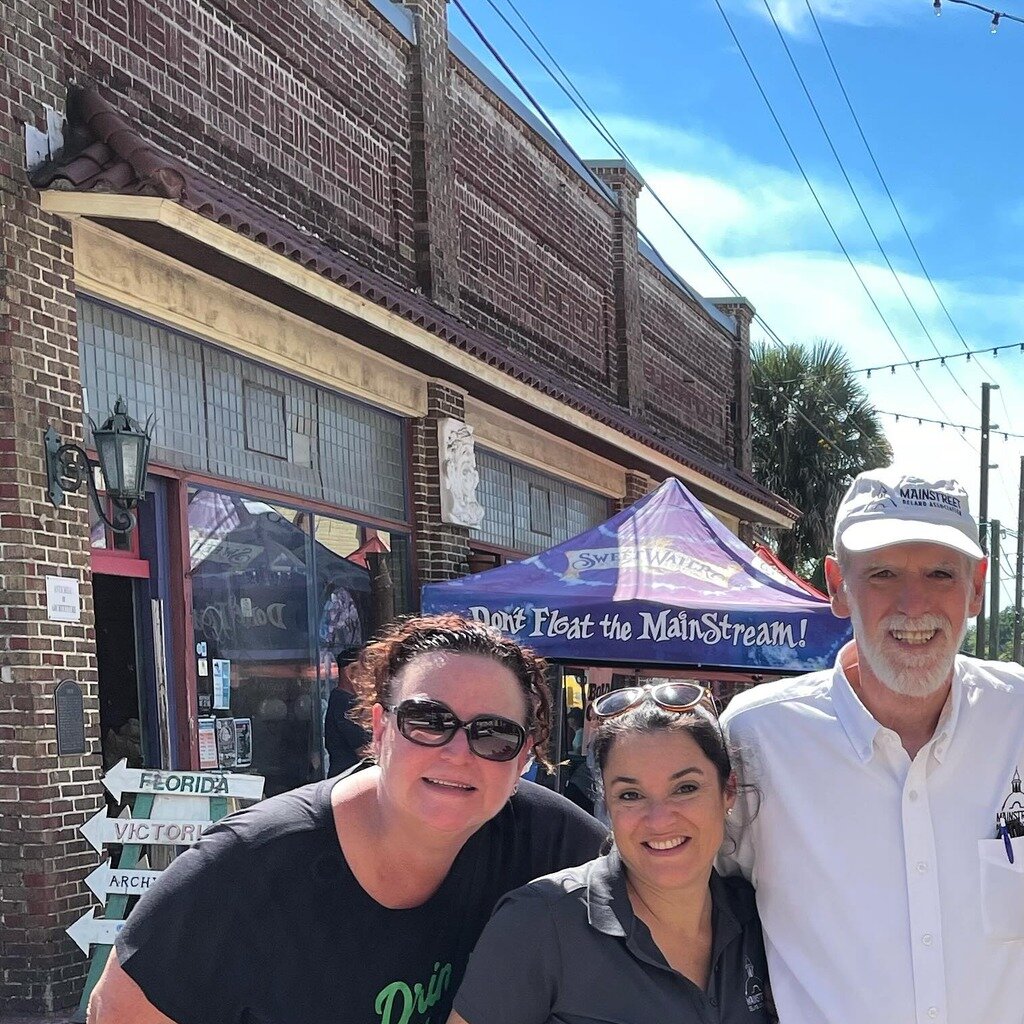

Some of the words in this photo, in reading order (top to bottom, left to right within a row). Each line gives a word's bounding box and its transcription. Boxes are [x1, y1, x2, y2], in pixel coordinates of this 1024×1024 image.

[900, 489, 961, 509] MAINSTREET
[528, 606, 596, 640] Float
[599, 612, 633, 642] the
[637, 610, 808, 648] MainStream!
[139, 772, 229, 794] FLORIDA
